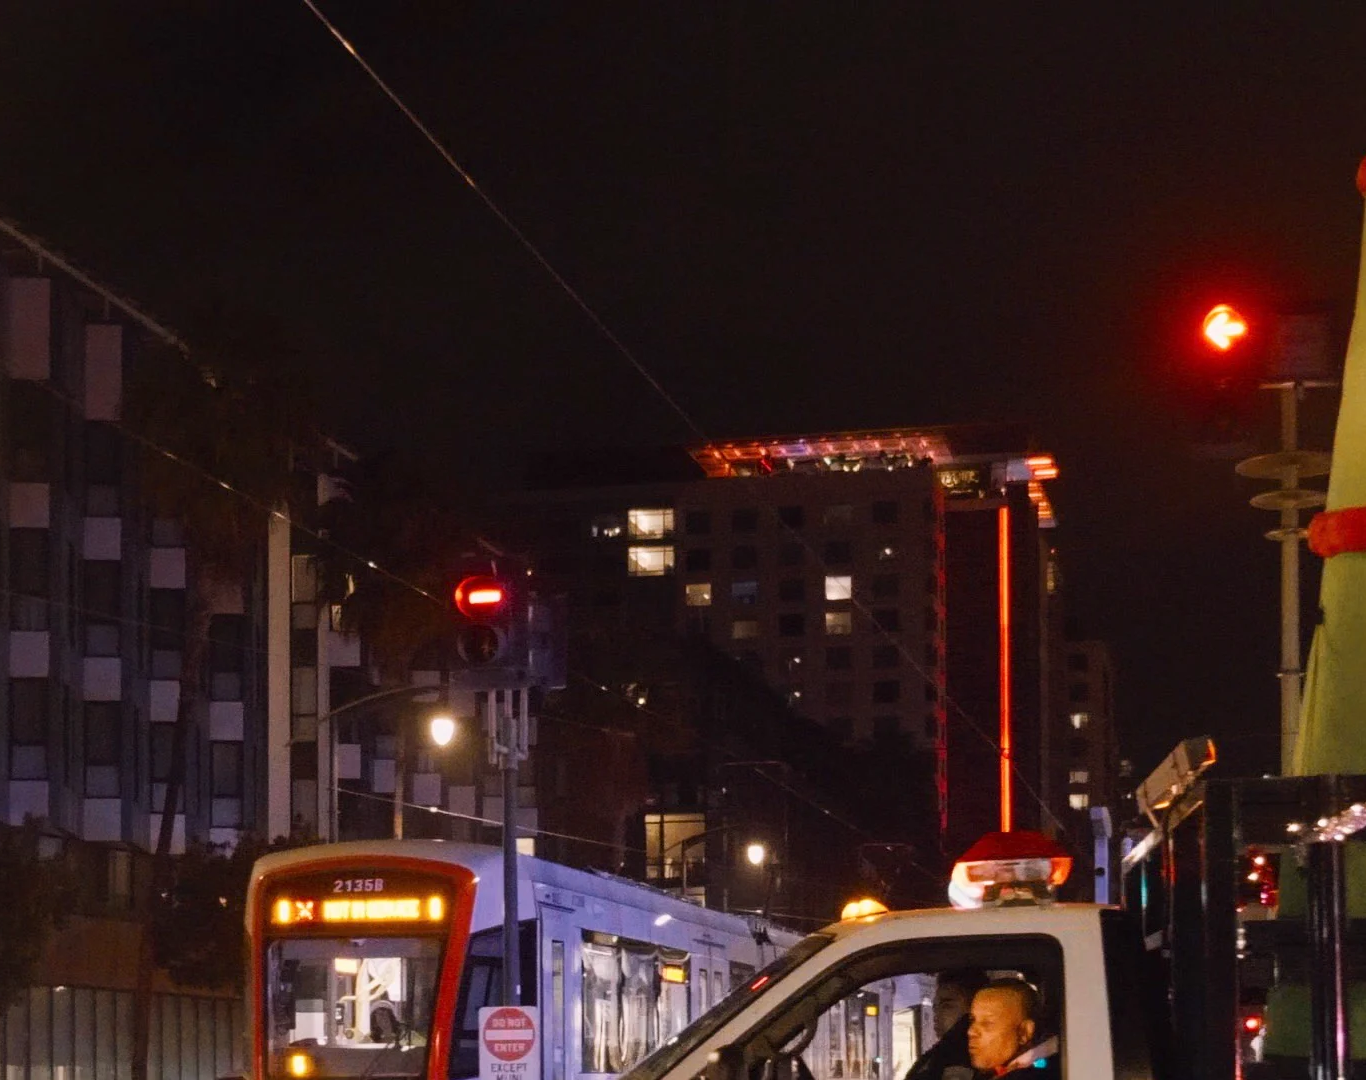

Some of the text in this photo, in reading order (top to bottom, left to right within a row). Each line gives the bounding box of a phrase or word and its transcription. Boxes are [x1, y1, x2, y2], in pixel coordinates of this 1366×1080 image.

[491, 1018, 526, 1028] DO NOT
[494, 1042, 525, 1052] ENTER
[490, 1063, 528, 1073] EXCEPT
